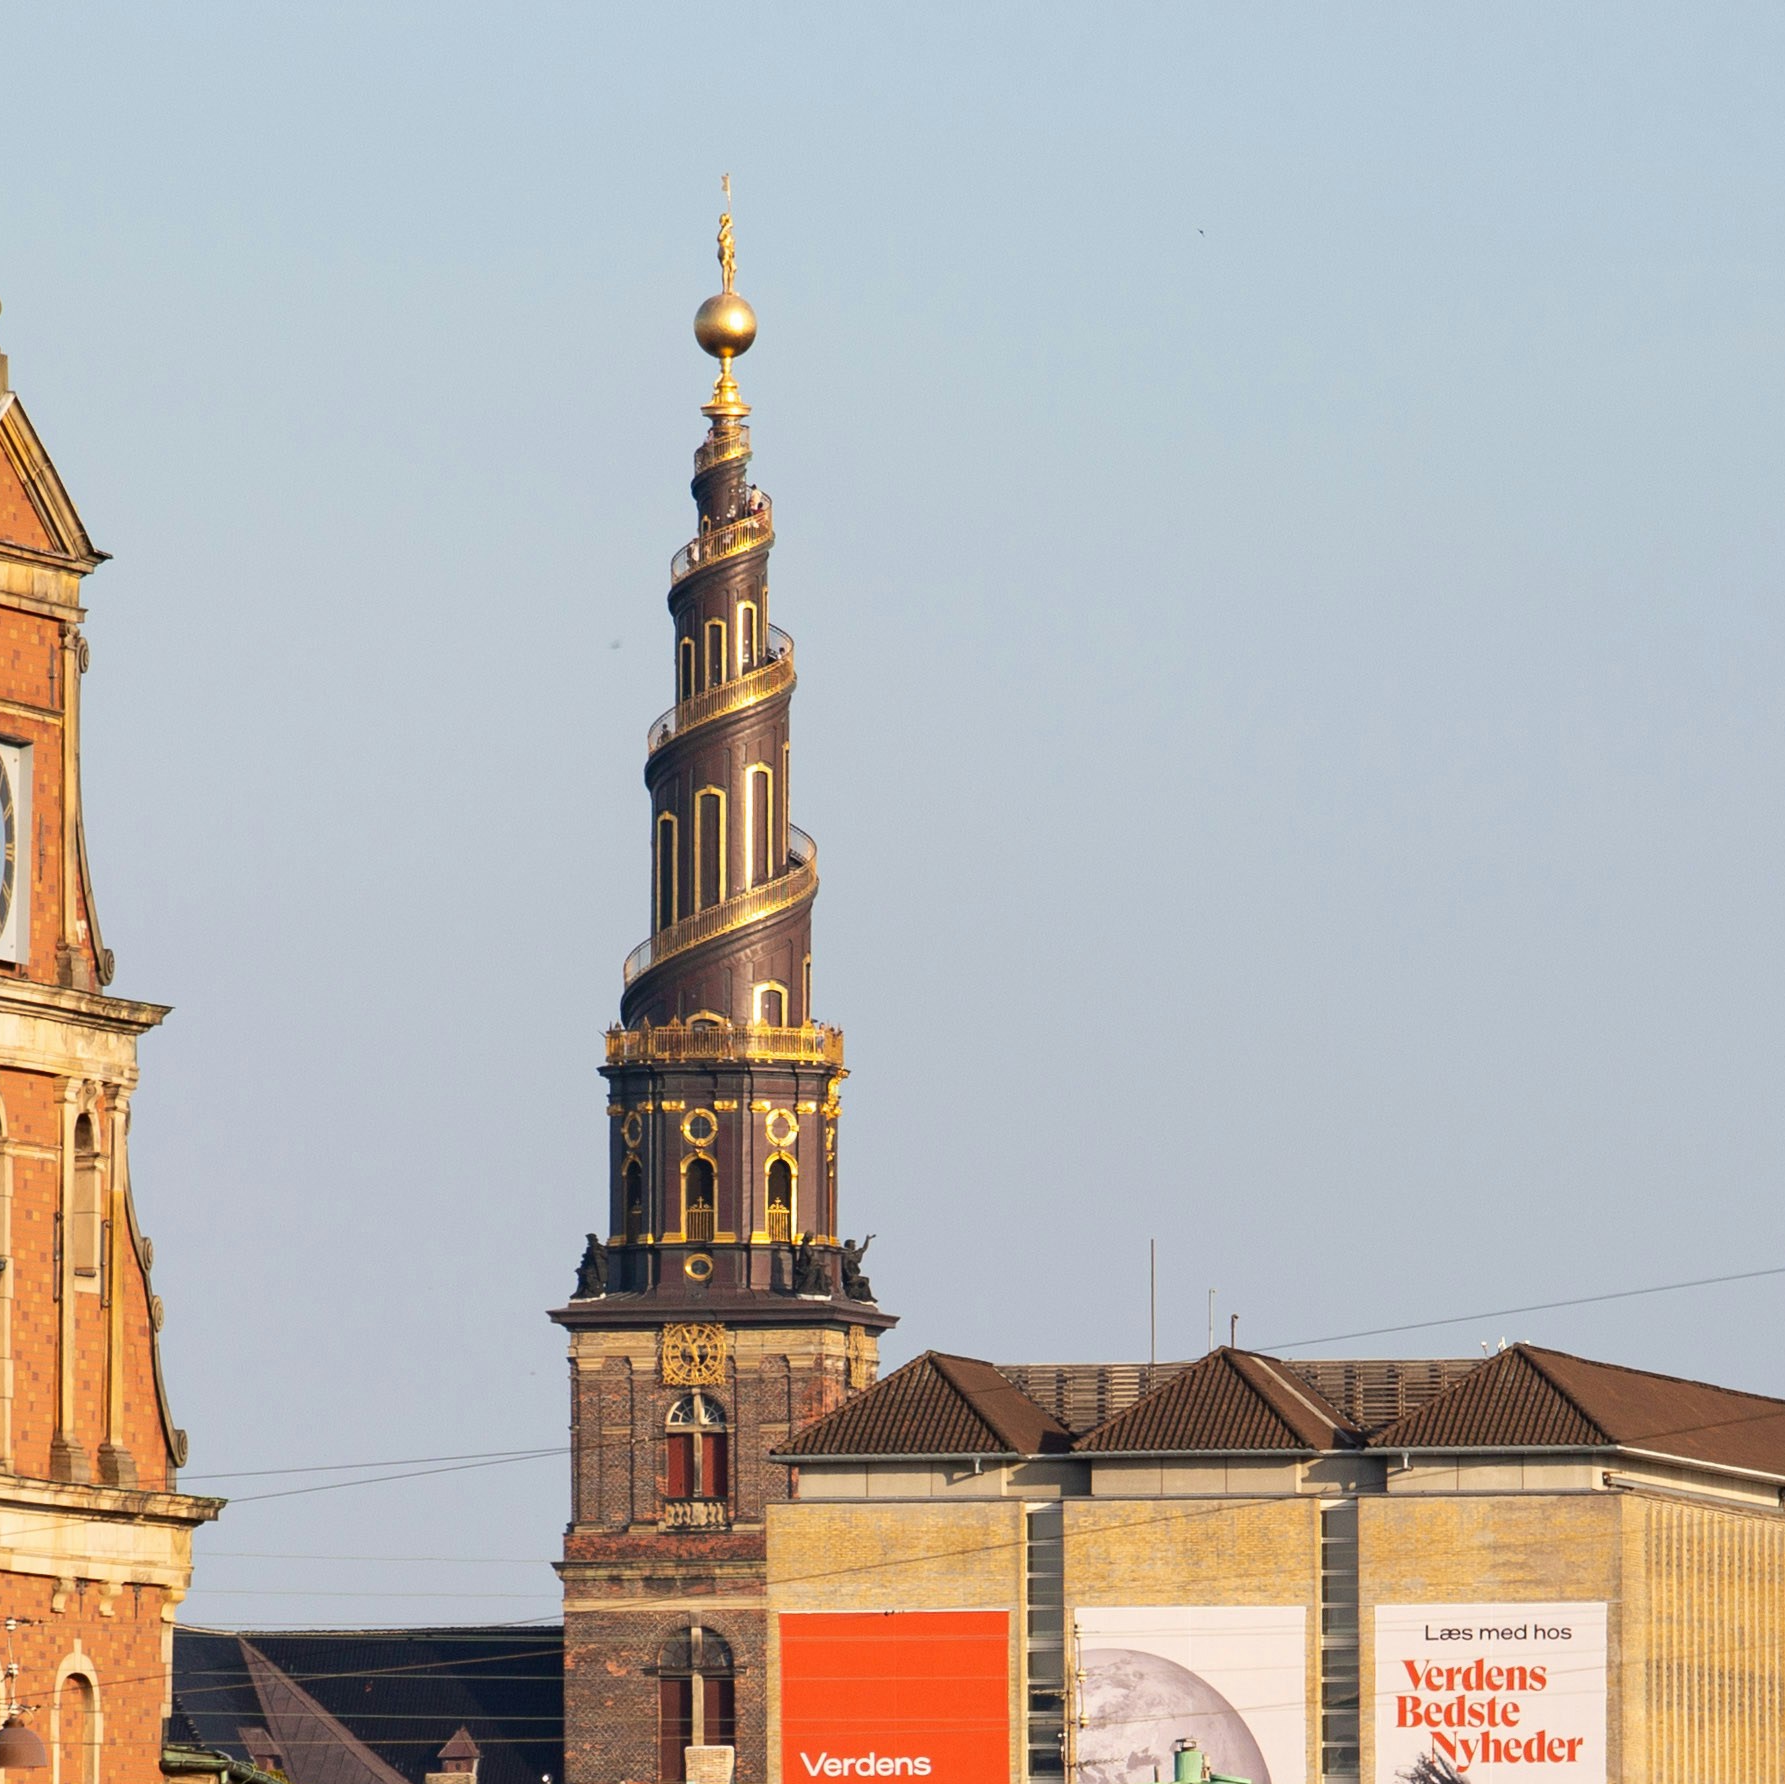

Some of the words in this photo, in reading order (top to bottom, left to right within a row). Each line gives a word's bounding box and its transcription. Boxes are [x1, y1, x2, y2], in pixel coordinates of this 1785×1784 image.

[1425, 1625, 1473, 1641] Læs
[1479, 1624, 1527, 1640] med
[1534, 1624, 1572, 1640] hos
[1402, 1658, 1548, 1692] Verdens
[1396, 1694, 1521, 1728] Bedste
[800, 1752, 932, 1777] Verdens
[1429, 1729, 1584, 1773] Nyheder
